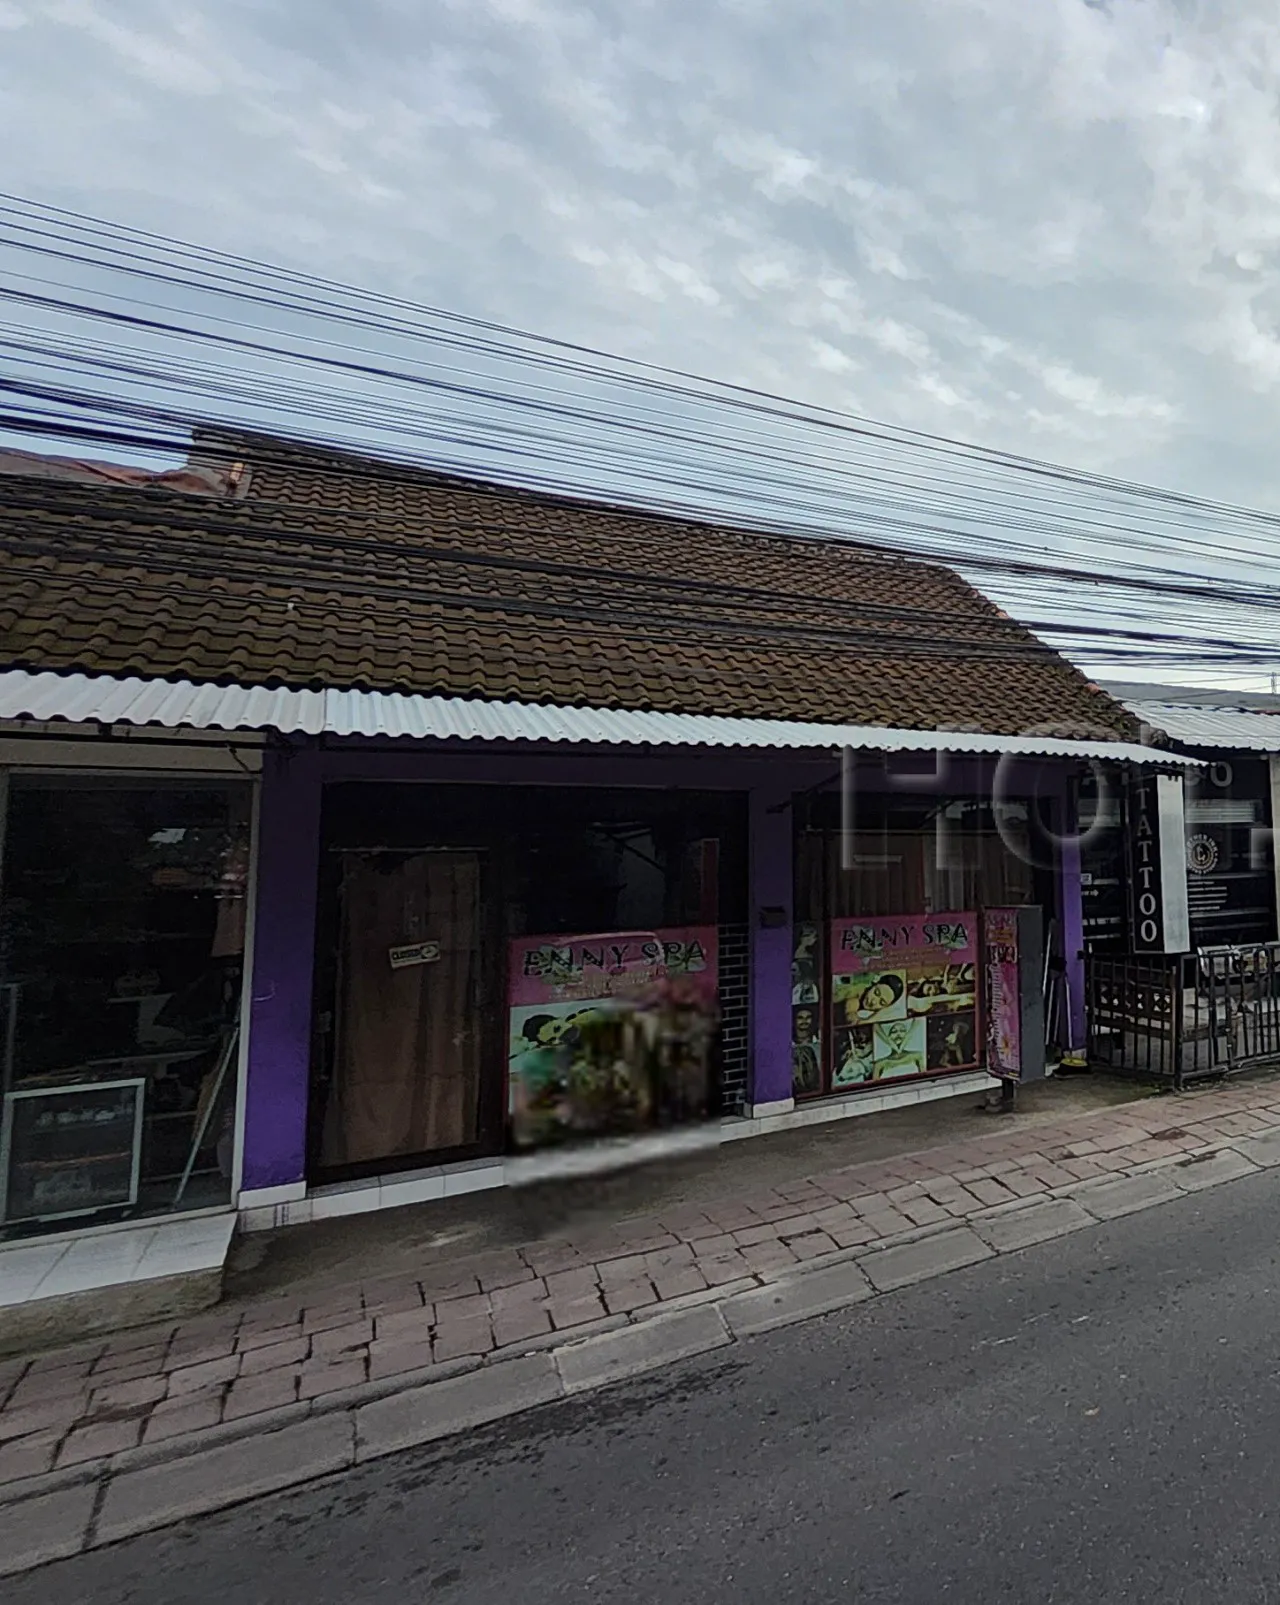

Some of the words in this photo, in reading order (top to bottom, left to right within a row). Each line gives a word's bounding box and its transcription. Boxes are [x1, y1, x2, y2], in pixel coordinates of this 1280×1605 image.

[1134, 787, 1158, 943] TATTOO
[922, 922, 969, 945] SPA
[641, 939, 707, 971] SPA
